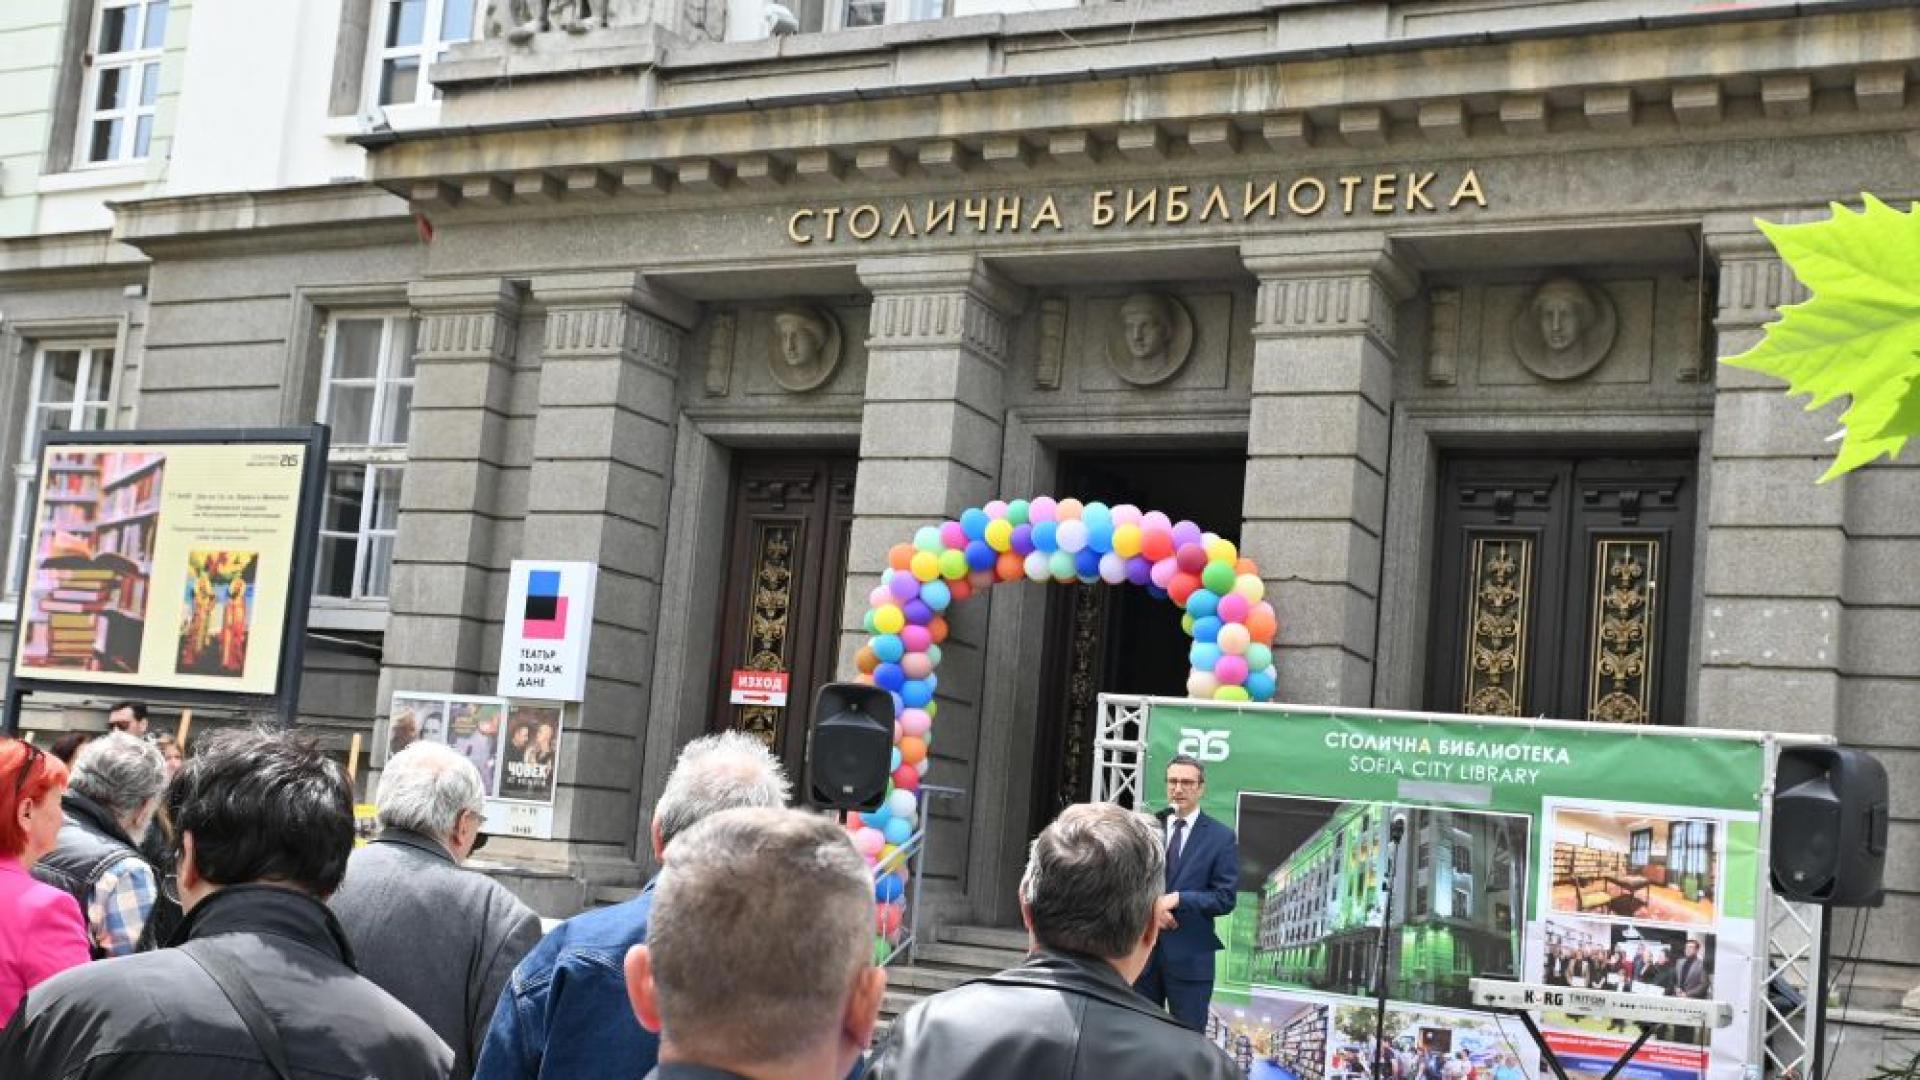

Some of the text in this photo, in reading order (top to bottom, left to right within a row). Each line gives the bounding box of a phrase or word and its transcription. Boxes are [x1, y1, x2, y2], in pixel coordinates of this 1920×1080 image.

[788, 168, 1489, 244] СТОЛИЧНА БИБЛИОТЕКА
[520, 648, 556, 660] ТЕАТЪР
[519, 663, 563, 674] ВЪЗРАЖ
[516, 676, 545, 687] ДАНЕ
[738, 676, 783, 692] ИЗХОД
[1324, 731, 1570, 765] СТОЛИЧНА БИБЛИОТЕКА
[1349, 755, 1540, 786] SOFIA CITY LIBRARY
